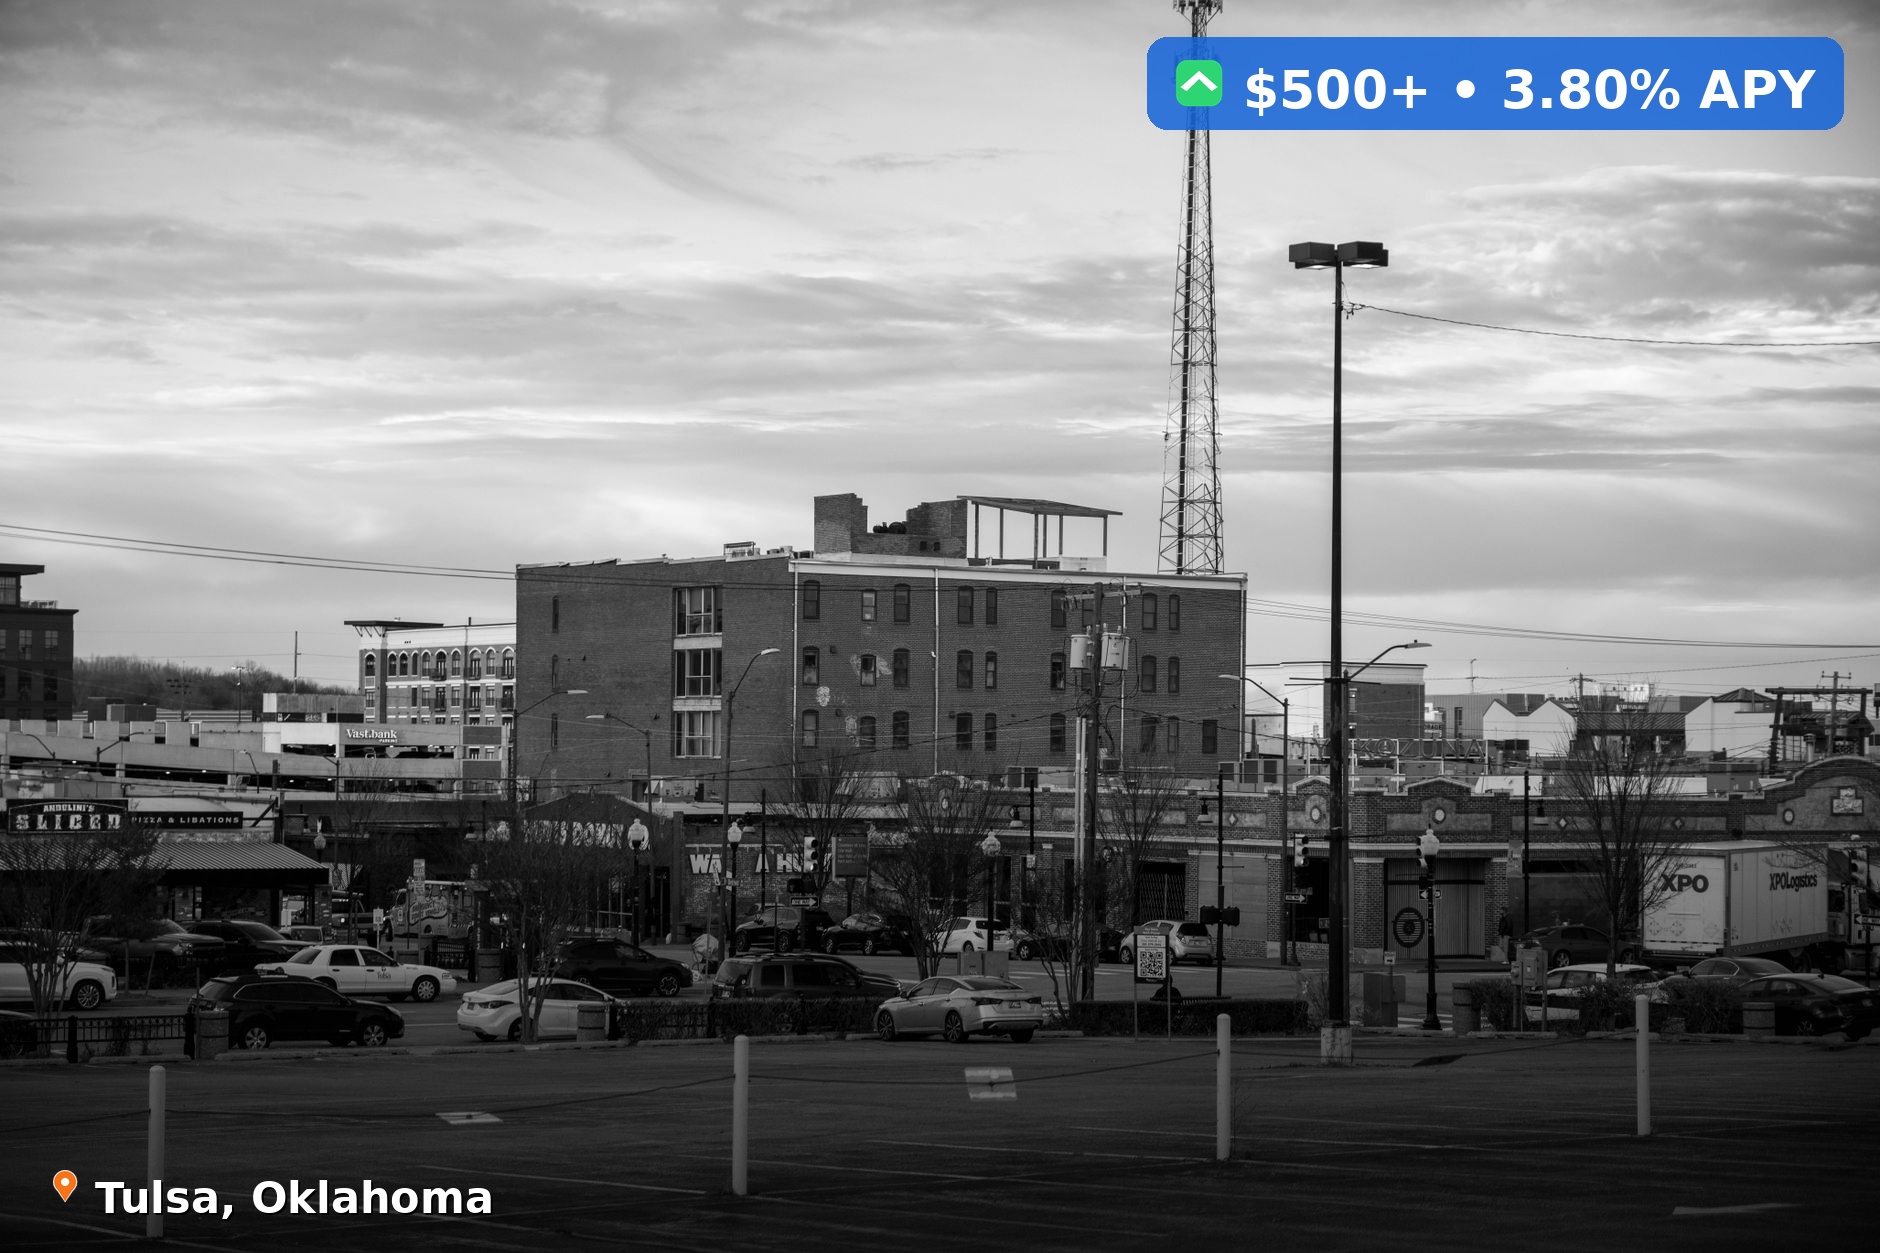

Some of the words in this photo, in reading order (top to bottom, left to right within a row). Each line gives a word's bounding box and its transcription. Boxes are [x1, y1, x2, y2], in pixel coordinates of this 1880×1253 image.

[1313, 738, 1486, 759] YKOZUNA
[16, 814, 121, 830] SLICED
[1662, 874, 1709, 893] XPO
